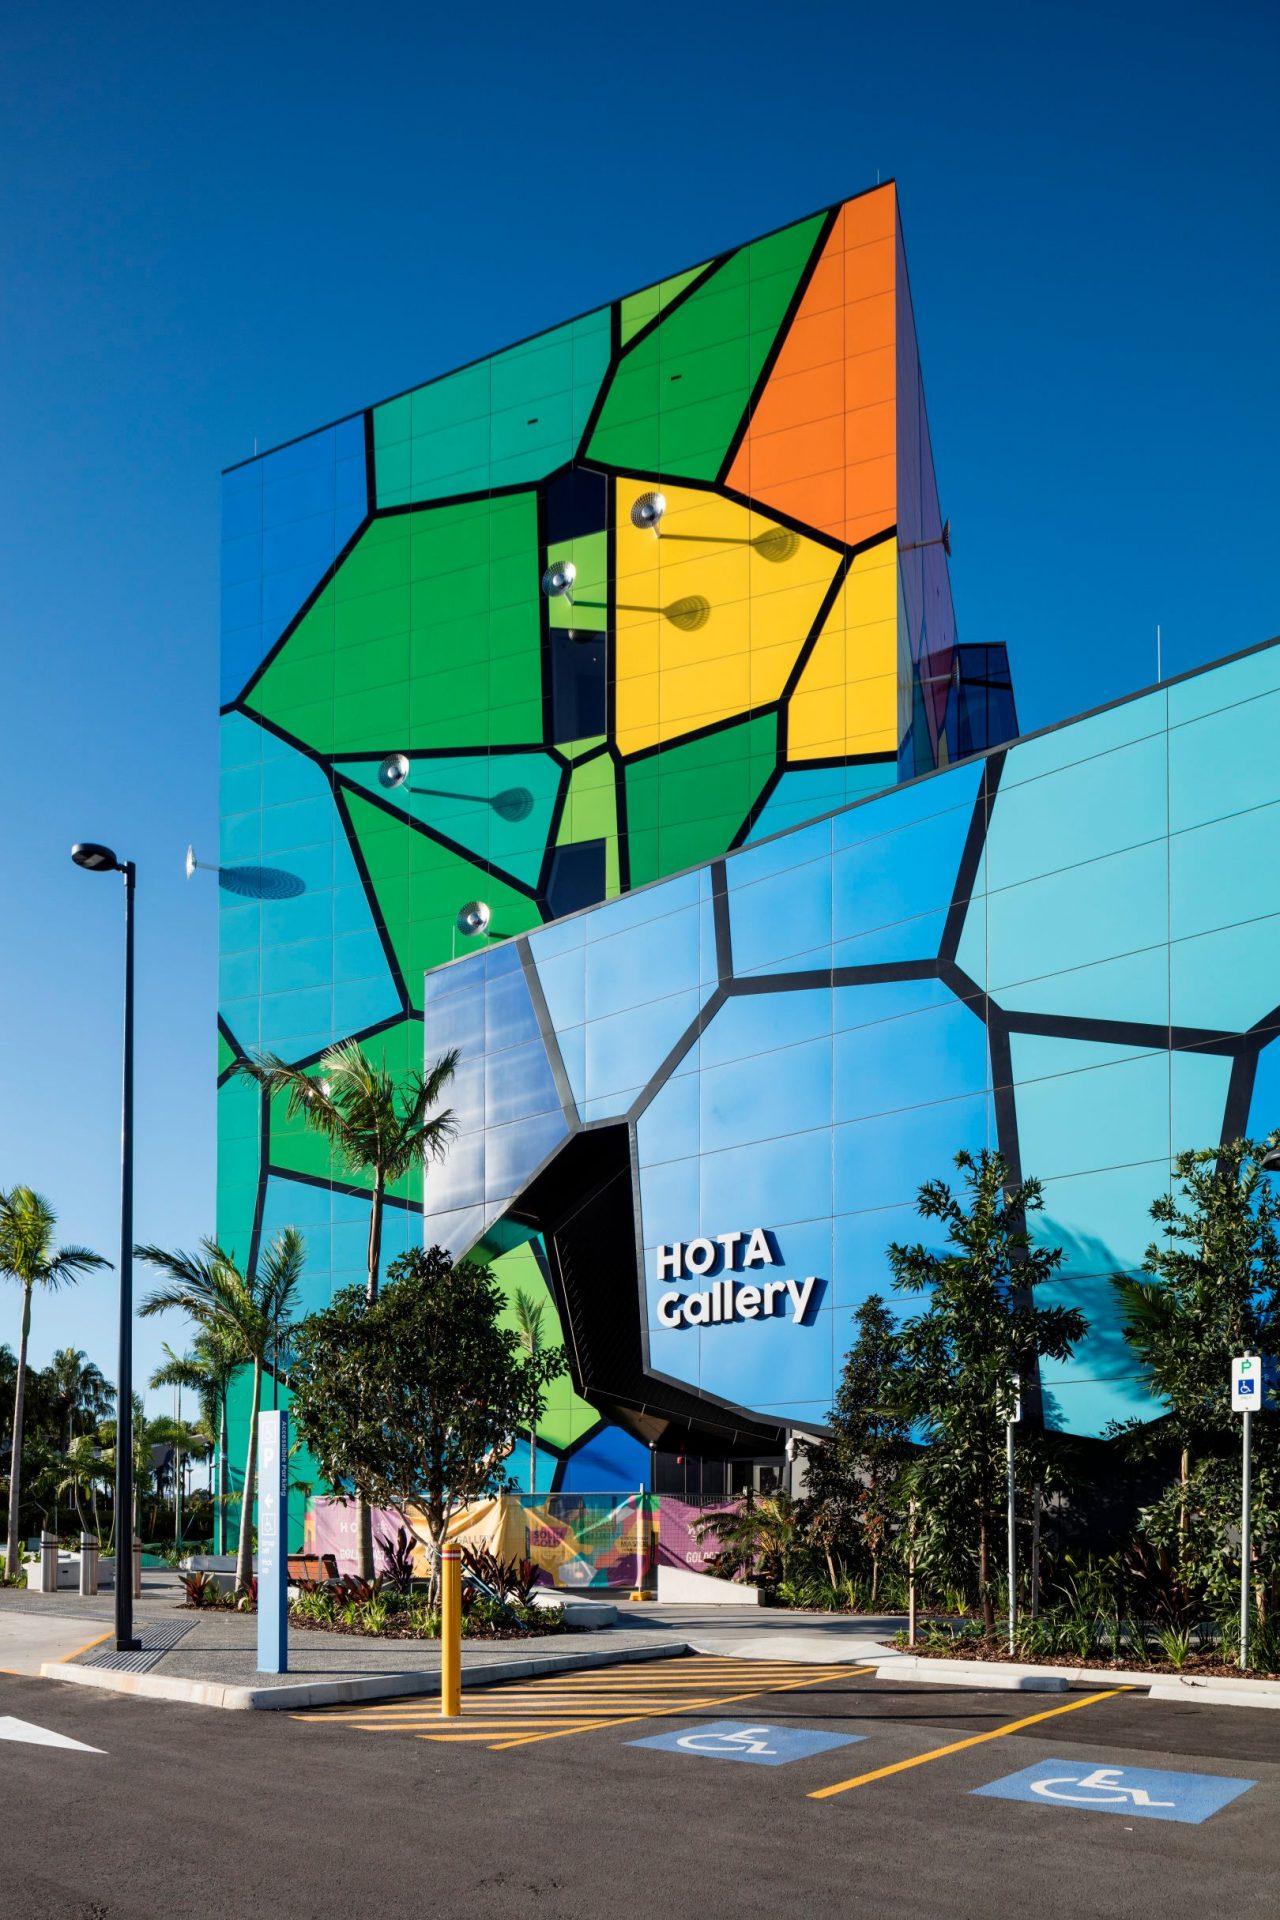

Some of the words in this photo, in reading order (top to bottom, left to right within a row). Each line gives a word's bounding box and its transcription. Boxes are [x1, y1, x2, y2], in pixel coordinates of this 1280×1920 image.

[656, 1228, 773, 1280] HOTA
[657, 1276, 816, 1328] Gallery
[1241, 1361, 1252, 1374] P
[263, 1447, 275, 1469] P
[280, 1464, 288, 1497] Parking
